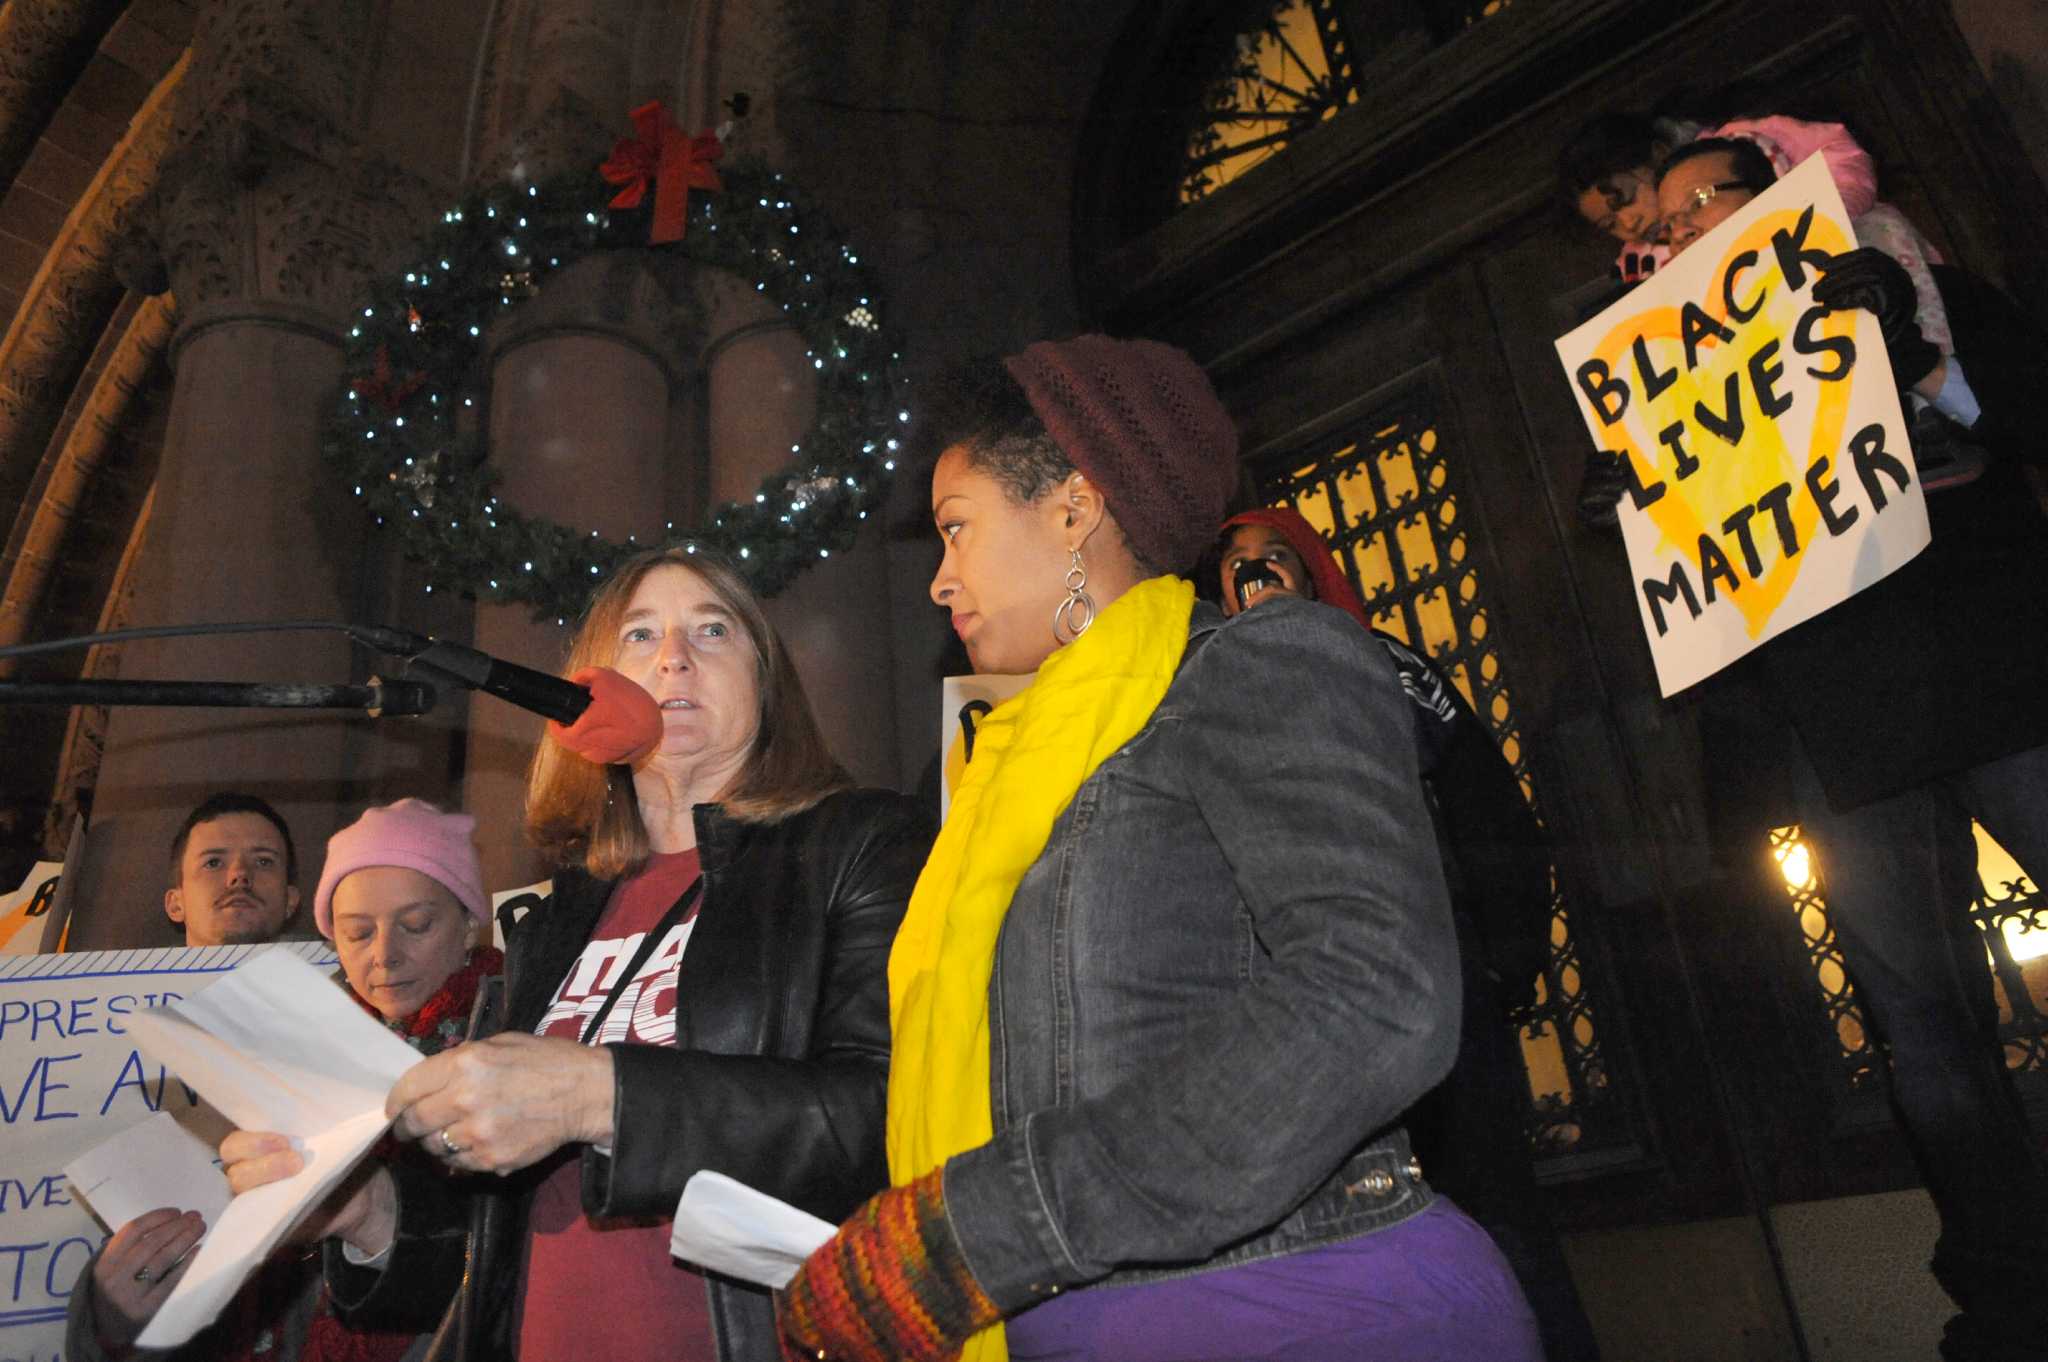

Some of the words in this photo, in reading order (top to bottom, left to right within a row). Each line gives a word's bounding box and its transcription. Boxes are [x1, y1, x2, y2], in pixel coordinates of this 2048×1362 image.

[1576, 203, 1837, 426] BLACK
[1616, 306, 1856, 512] LIVES
[1641, 423, 1911, 638] MATTER
[0, 992, 183, 1041] PRES
